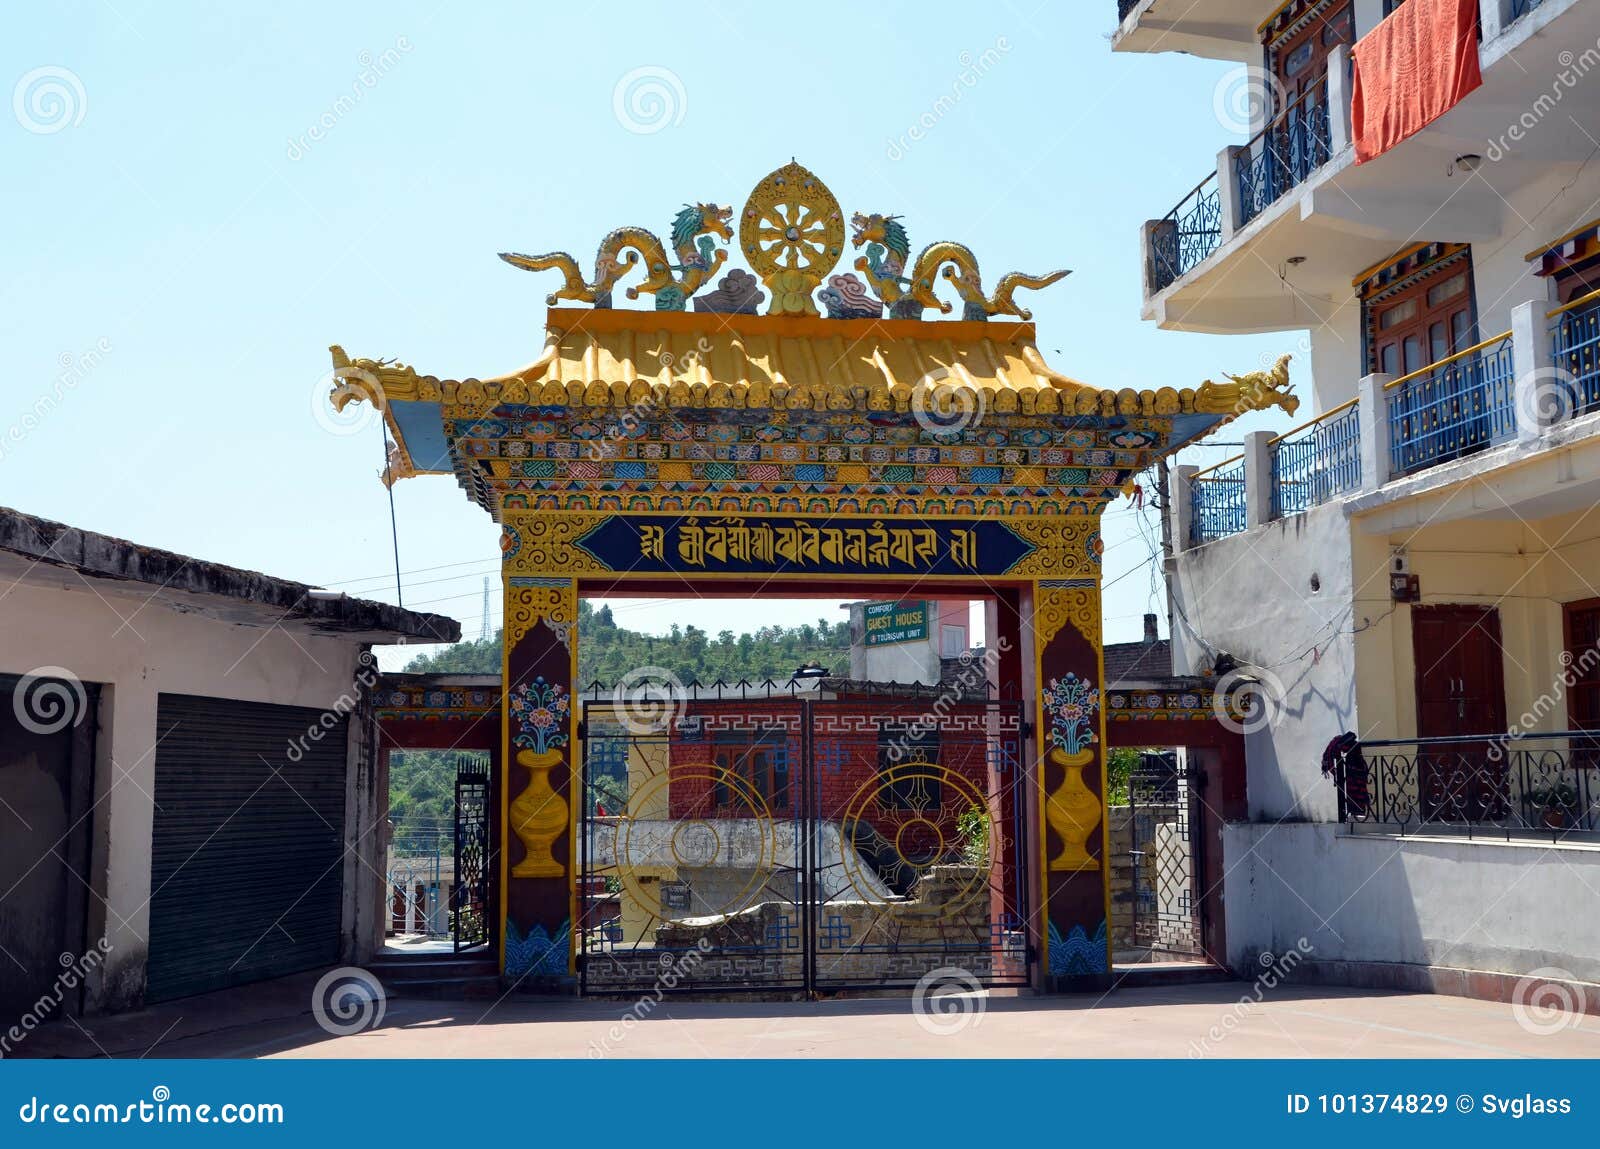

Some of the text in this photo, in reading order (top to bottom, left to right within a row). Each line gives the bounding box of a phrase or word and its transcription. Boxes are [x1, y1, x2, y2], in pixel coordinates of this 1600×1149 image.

[868, 604, 893, 614] COMFORT
[867, 611, 922, 630] GUEST HOUSE
[907, 629, 920, 638] UNIT
